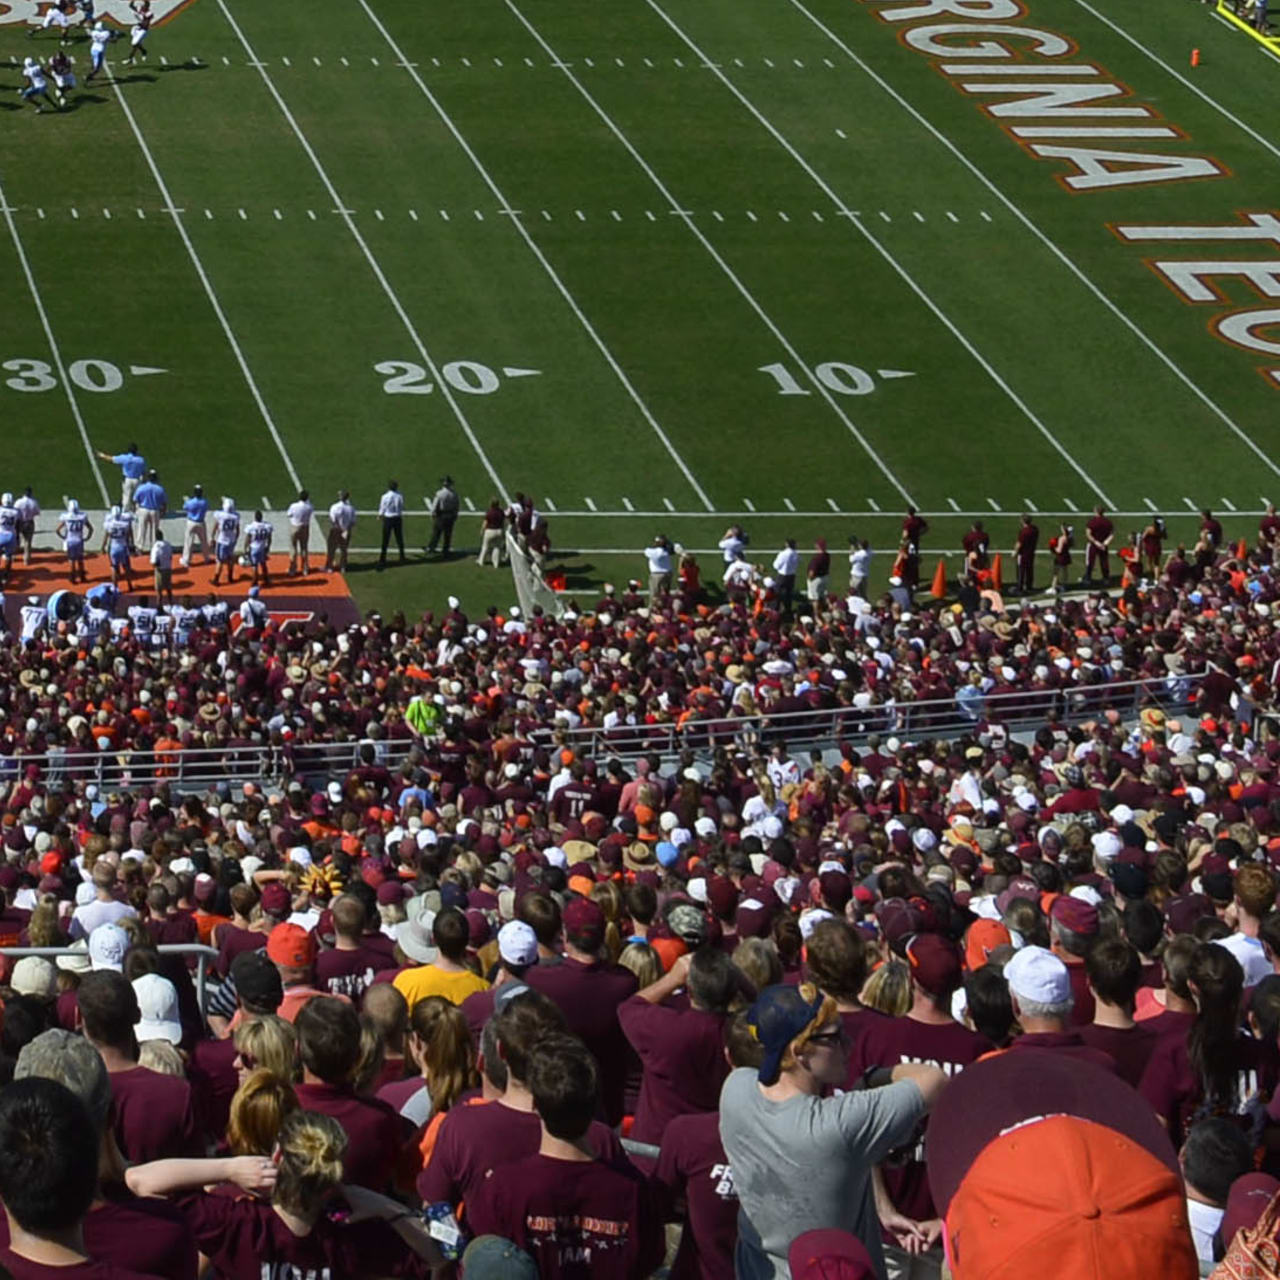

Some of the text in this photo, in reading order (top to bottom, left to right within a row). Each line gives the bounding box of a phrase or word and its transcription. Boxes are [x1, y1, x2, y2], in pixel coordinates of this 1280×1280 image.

[1, 358, 124, 393] 30
[373, 360, 501, 395] 20
[758, 361, 876, 396] 10
[25, 608, 43, 625] 77
